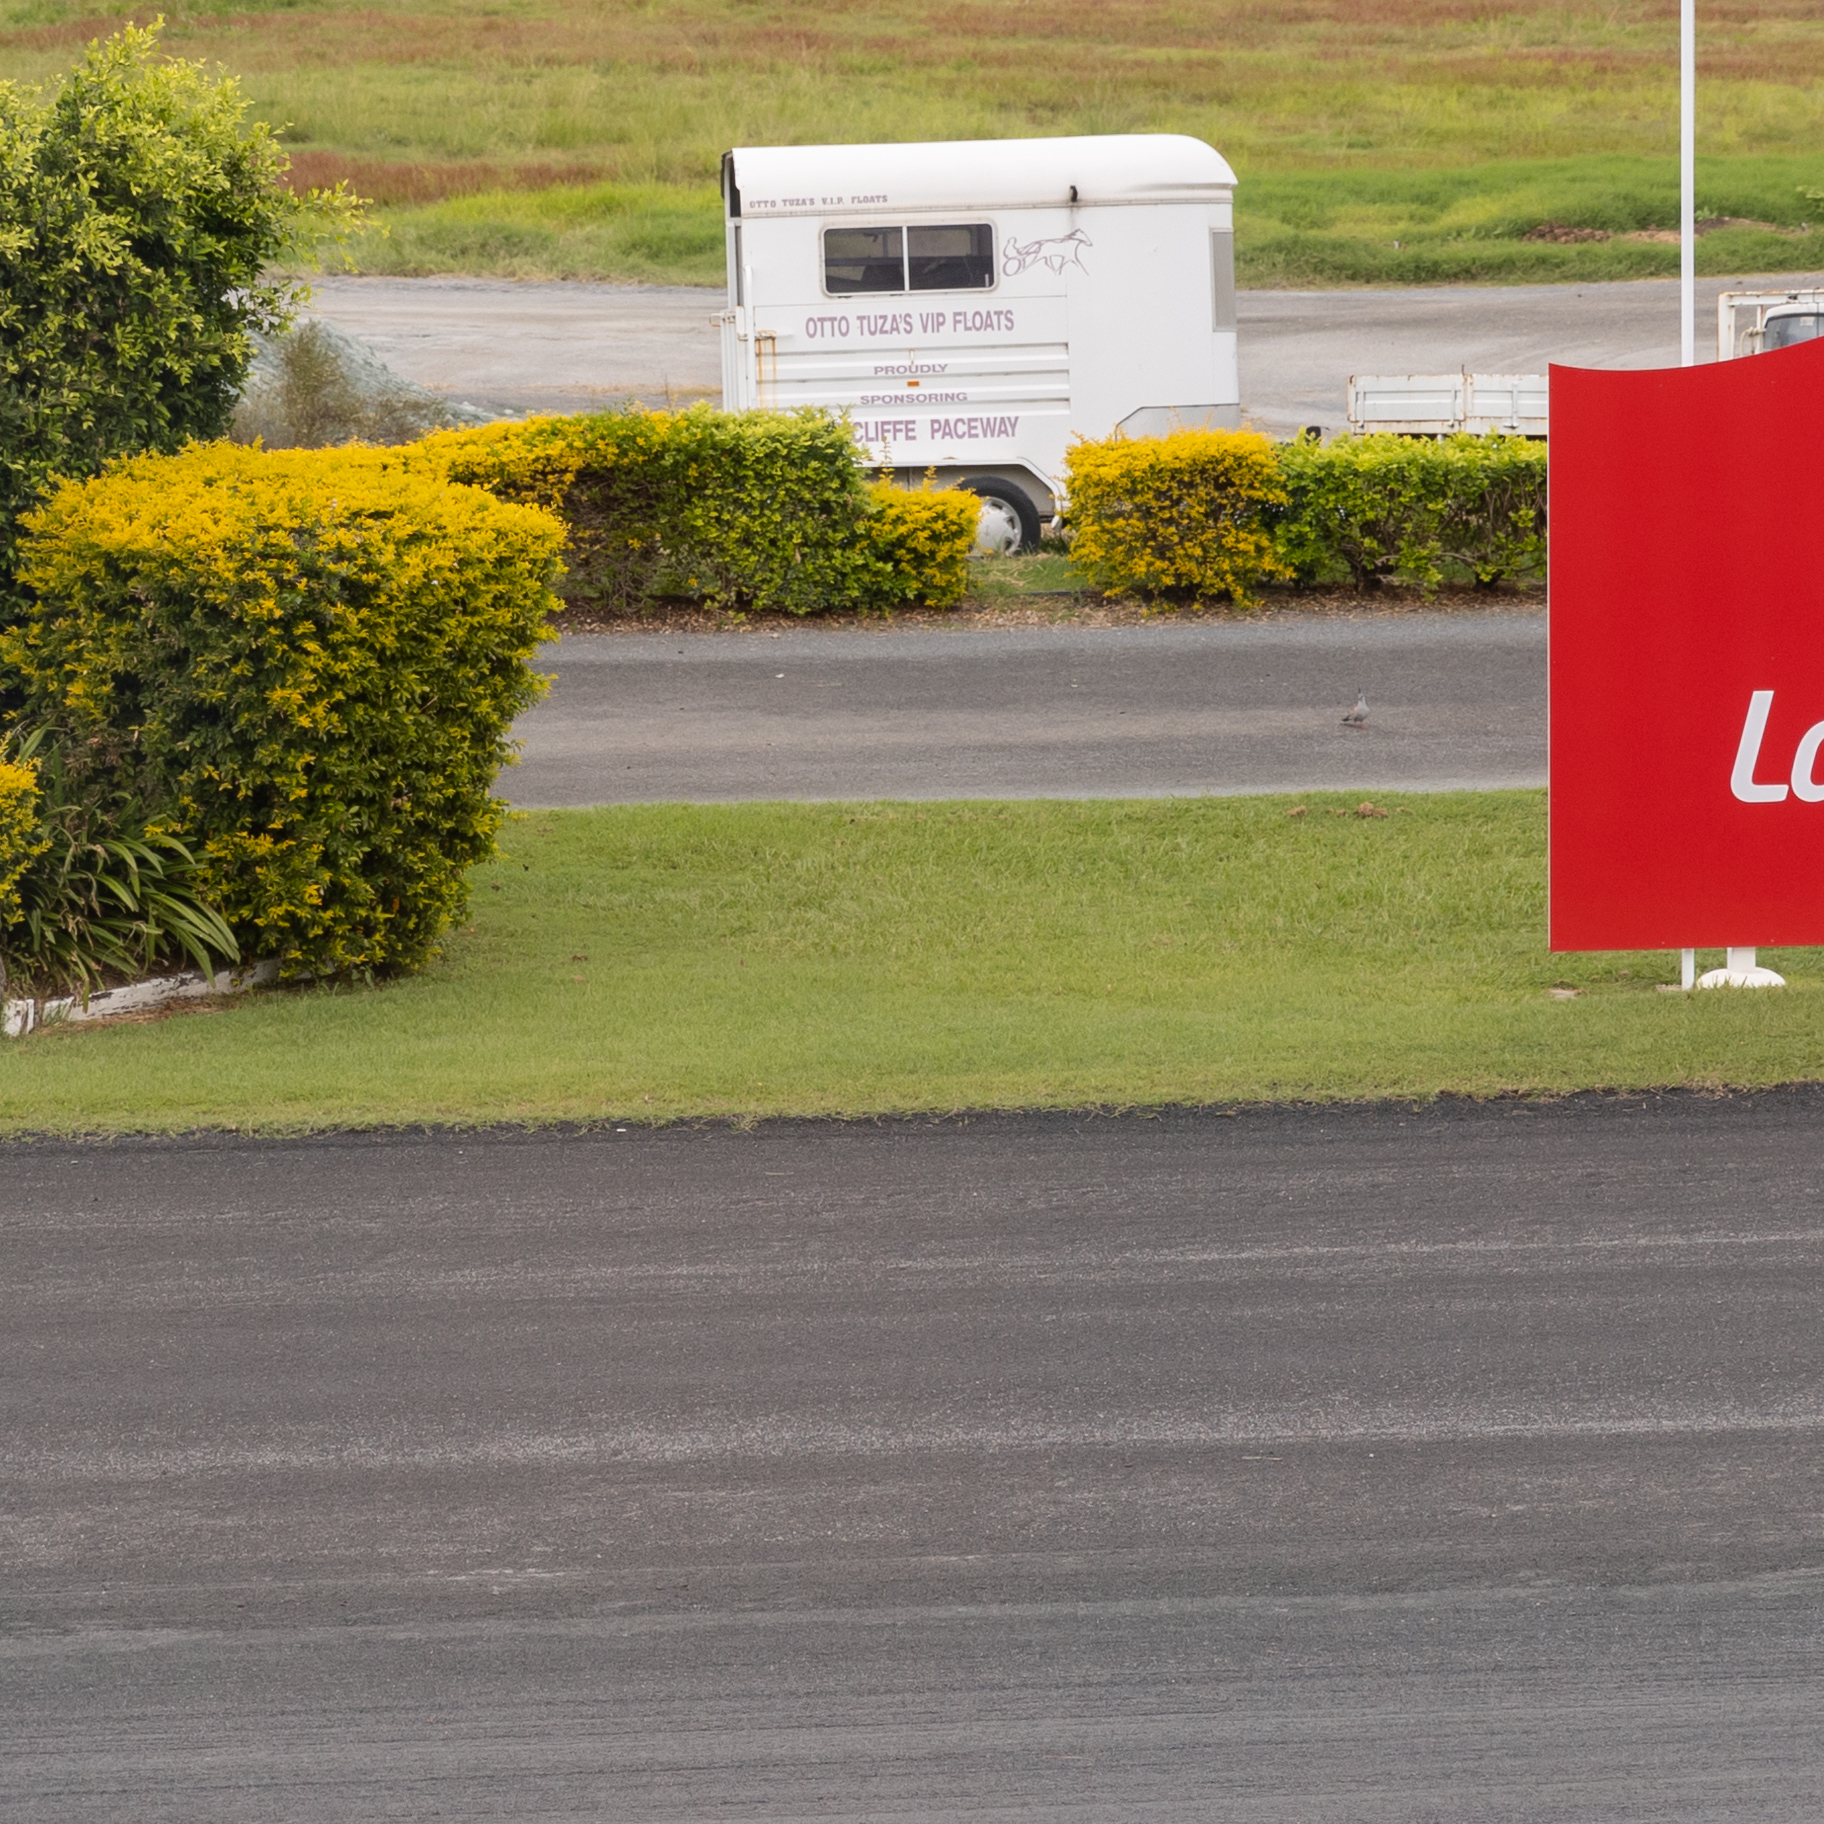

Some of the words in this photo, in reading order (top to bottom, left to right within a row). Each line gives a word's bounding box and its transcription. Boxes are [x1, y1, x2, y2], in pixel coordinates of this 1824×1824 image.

[749, 200, 777, 209] OTTO
[851, 195, 888, 204] FLOATS
[805, 315, 850, 338] OTTO
[856, 312, 914, 336] TUZA'S
[919, 311, 946, 334] VIP
[952, 309, 1015, 333] FLOATS
[873, 363, 948, 376] PROUDLY
[860, 392, 968, 405] SPONSORING
[852, 419, 917, 443] CLIFFE
[930, 416, 1019, 441] PACEWAY
